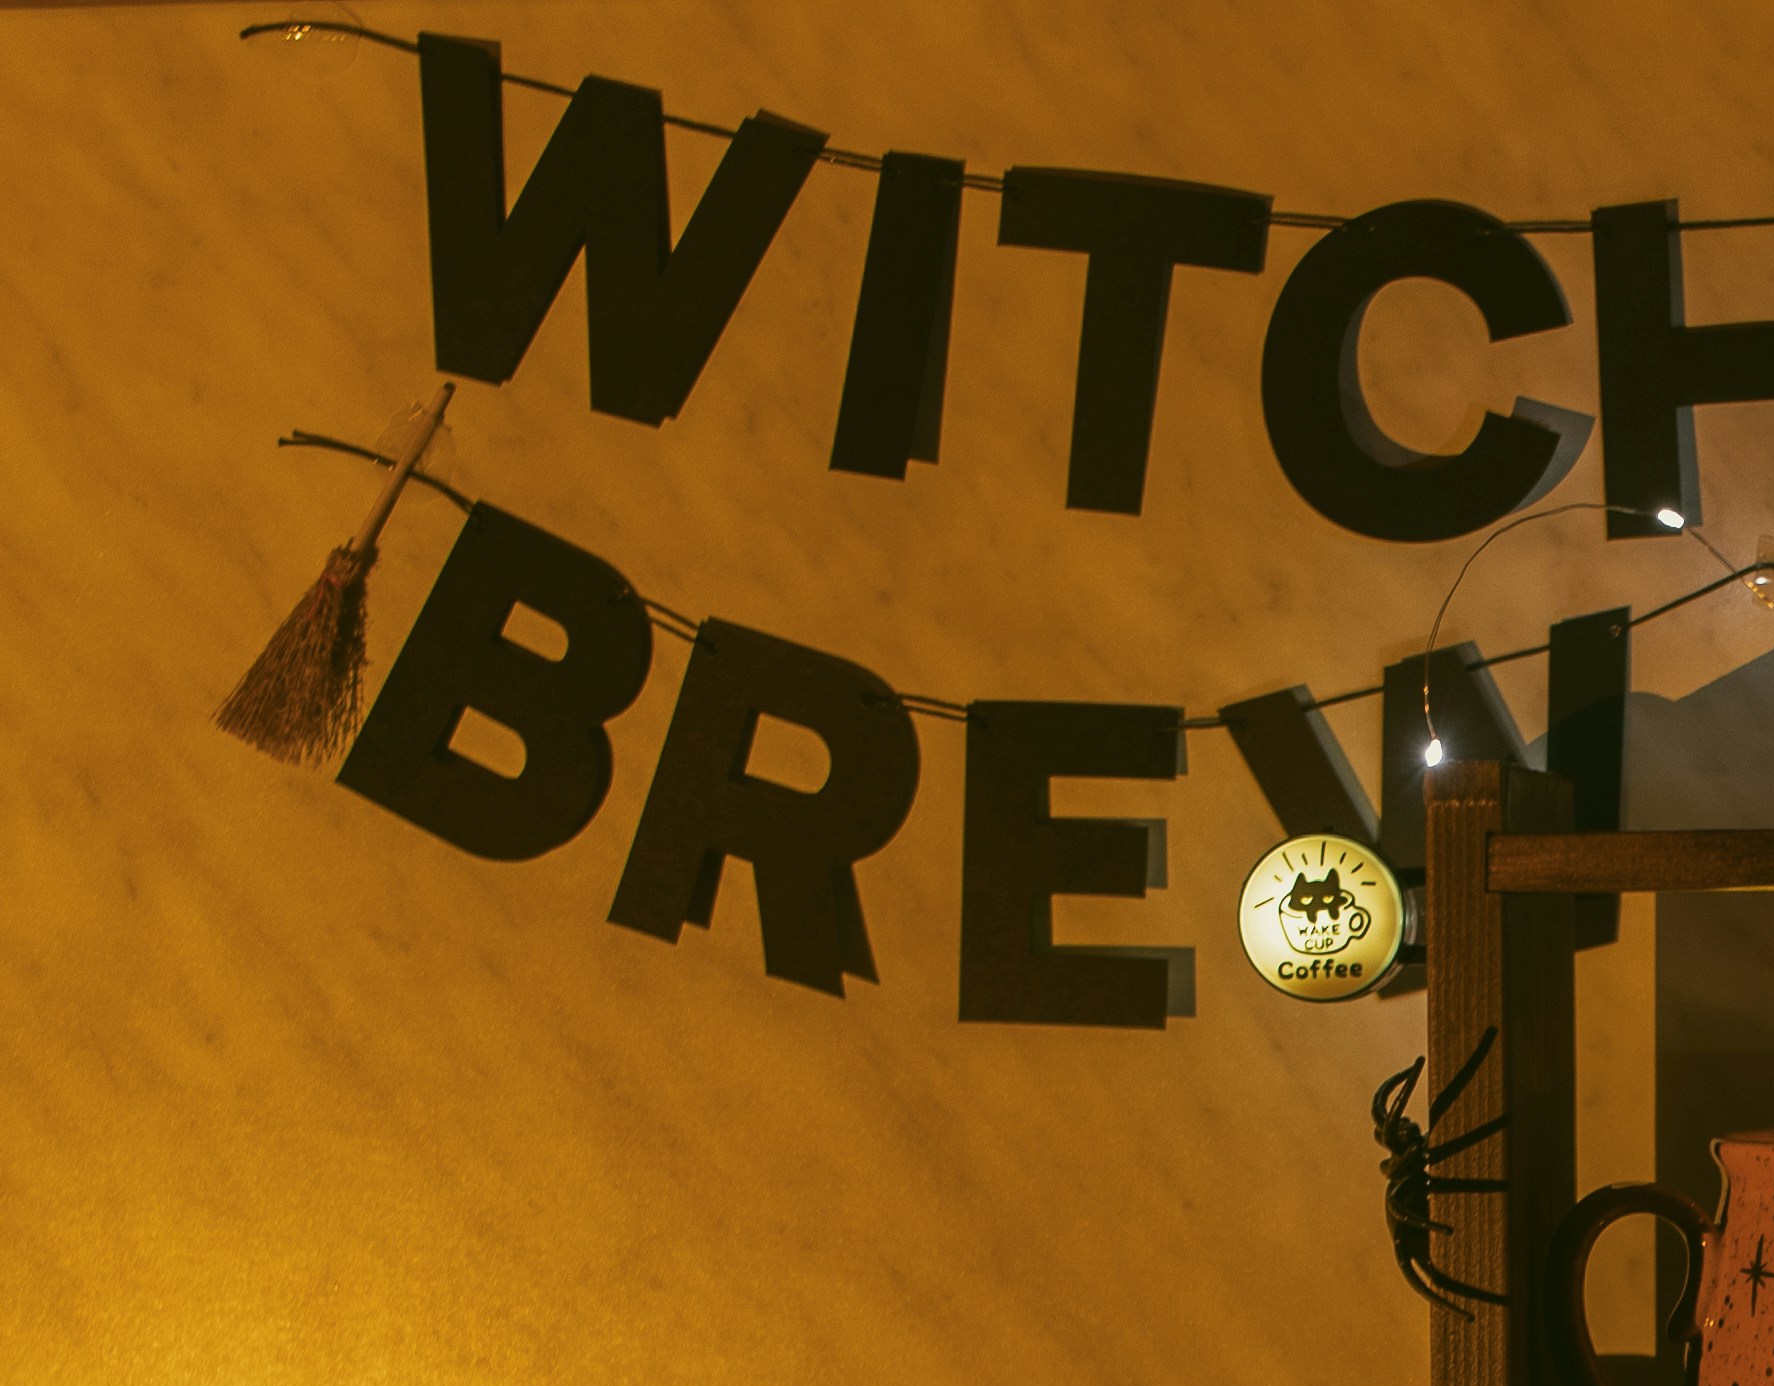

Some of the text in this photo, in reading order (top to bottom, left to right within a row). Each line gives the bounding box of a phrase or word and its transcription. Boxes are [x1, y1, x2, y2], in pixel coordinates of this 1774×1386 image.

[1299, 924, 1340, 936] WAKE
[1304, 938, 1334, 951] CUP
[1277, 959, 1363, 980] Coffee
